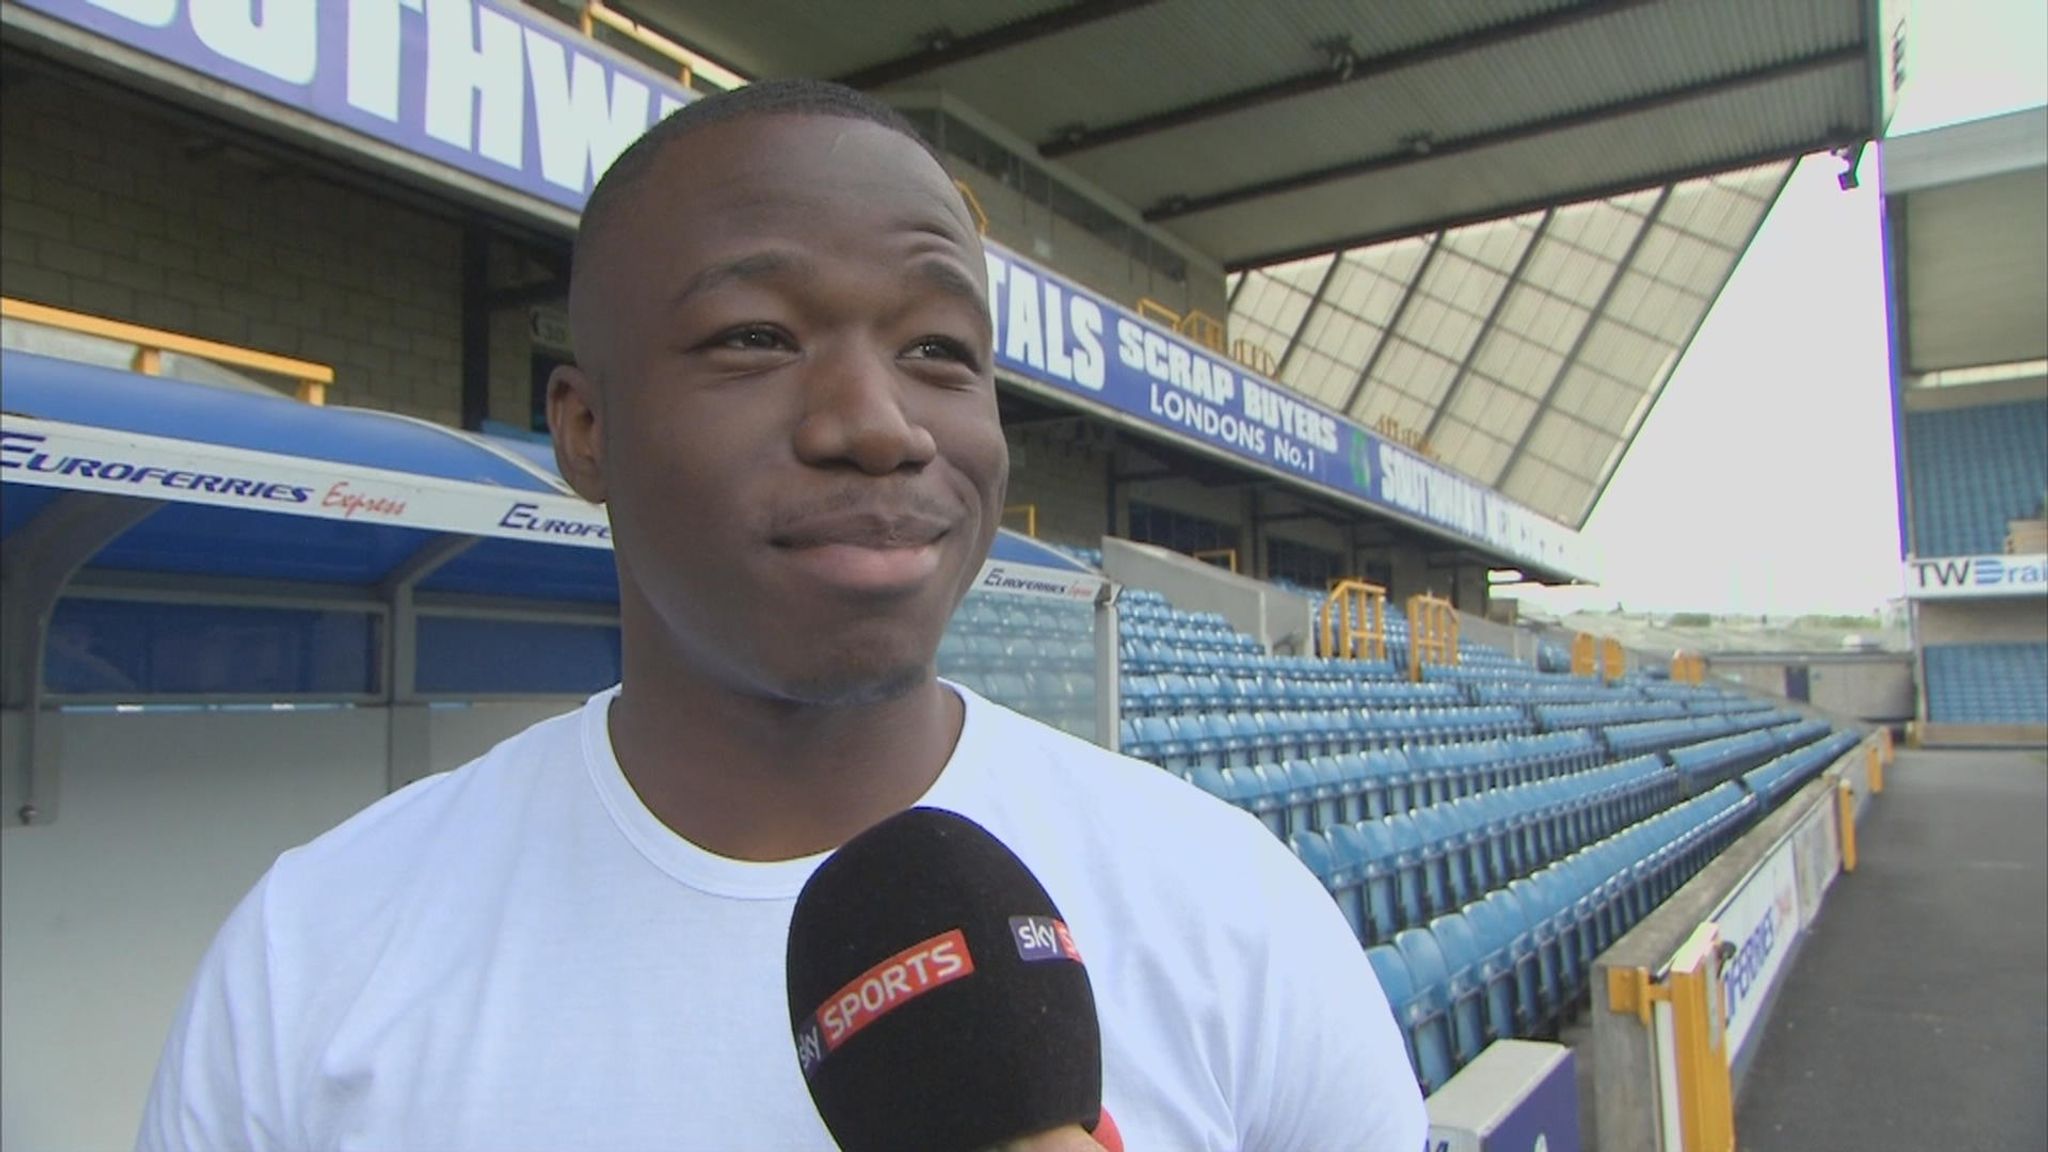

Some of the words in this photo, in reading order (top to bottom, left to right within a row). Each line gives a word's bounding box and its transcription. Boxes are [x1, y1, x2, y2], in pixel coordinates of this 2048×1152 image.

[1117, 318, 1234, 406] SCRAP
[1243, 378, 1338, 453] BUYERS
[1151, 383, 1265, 454] LONDONS
[1274, 436, 1315, 472] No.1
[321, 481, 407, 517] Express
[1018, 917, 1057, 954] sky
[823, 941, 963, 1040] SPORTS
